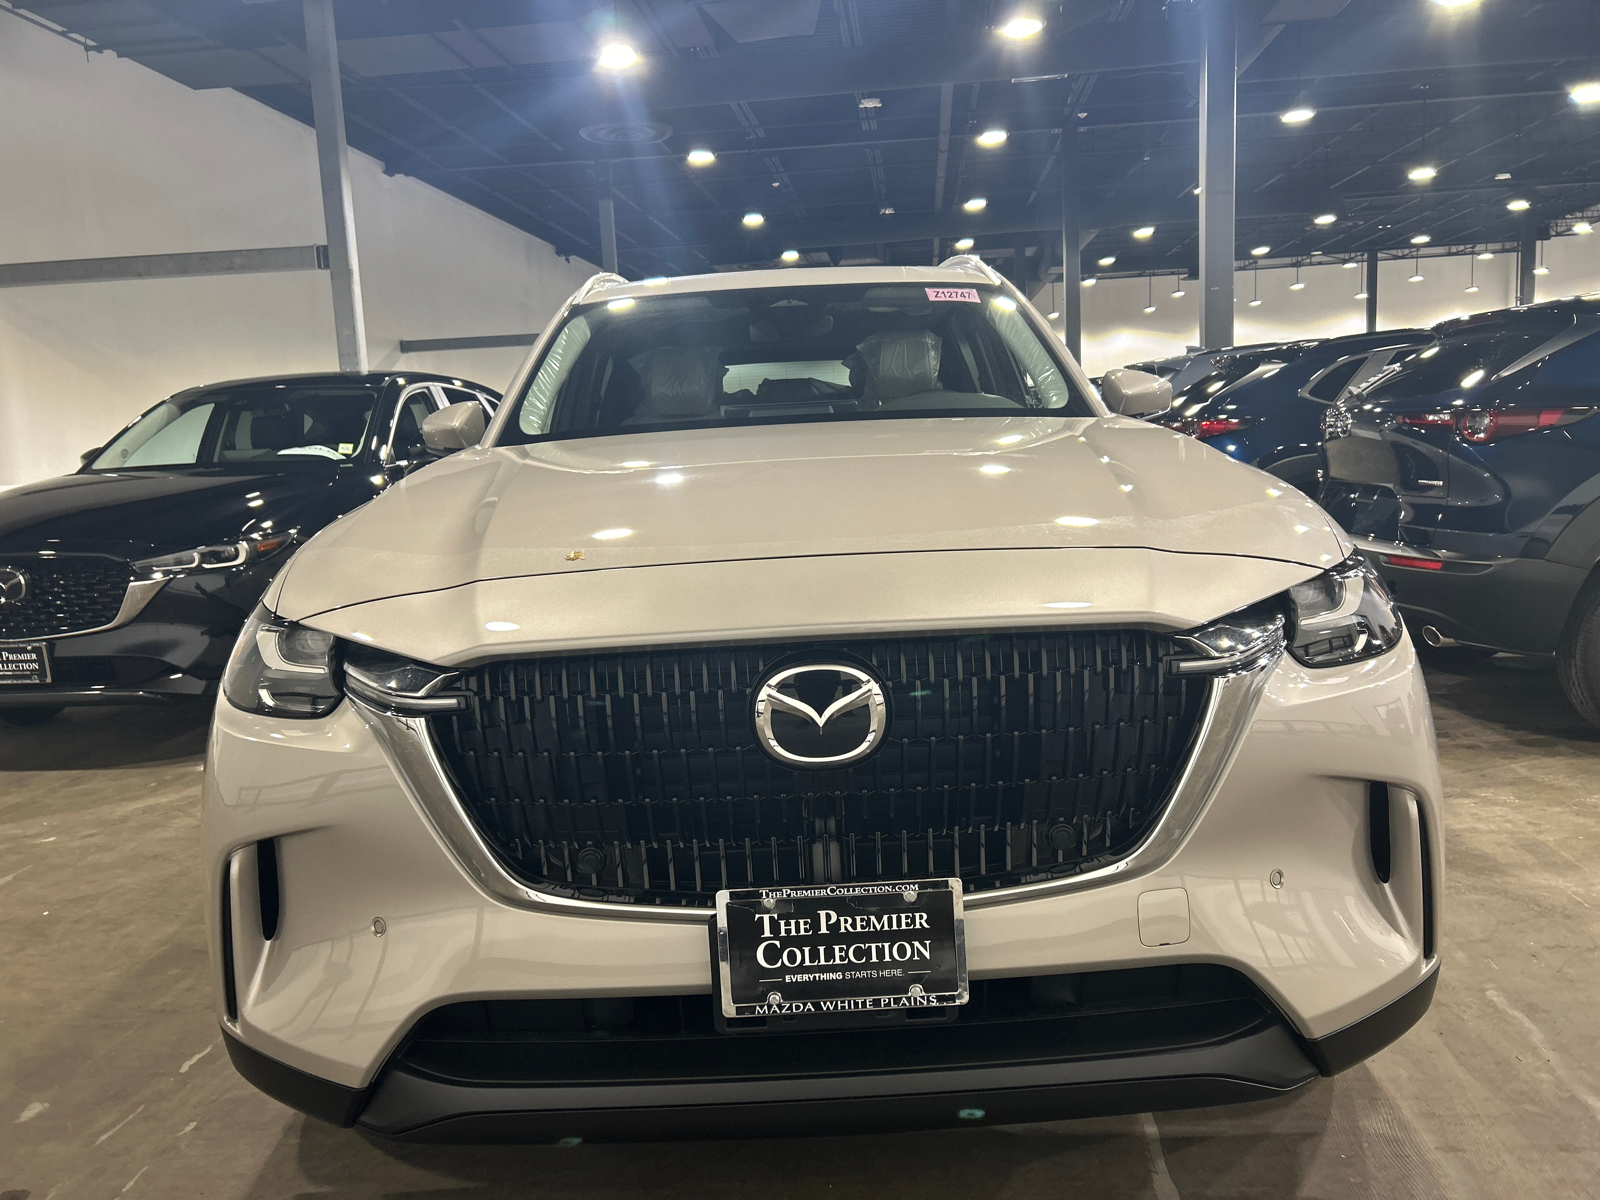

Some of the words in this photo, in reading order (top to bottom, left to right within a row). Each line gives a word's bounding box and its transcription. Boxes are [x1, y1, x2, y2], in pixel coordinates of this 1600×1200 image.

[1, 652, 37, 661] PREMIER
[785, 971, 843, 983] EVERYTHING
[845, 970, 877, 979] STARTS
[879, 969, 905, 978] HERE.
[755, 1002, 815, 1015] MAZDA
[820, 998, 874, 1011] WHITE
